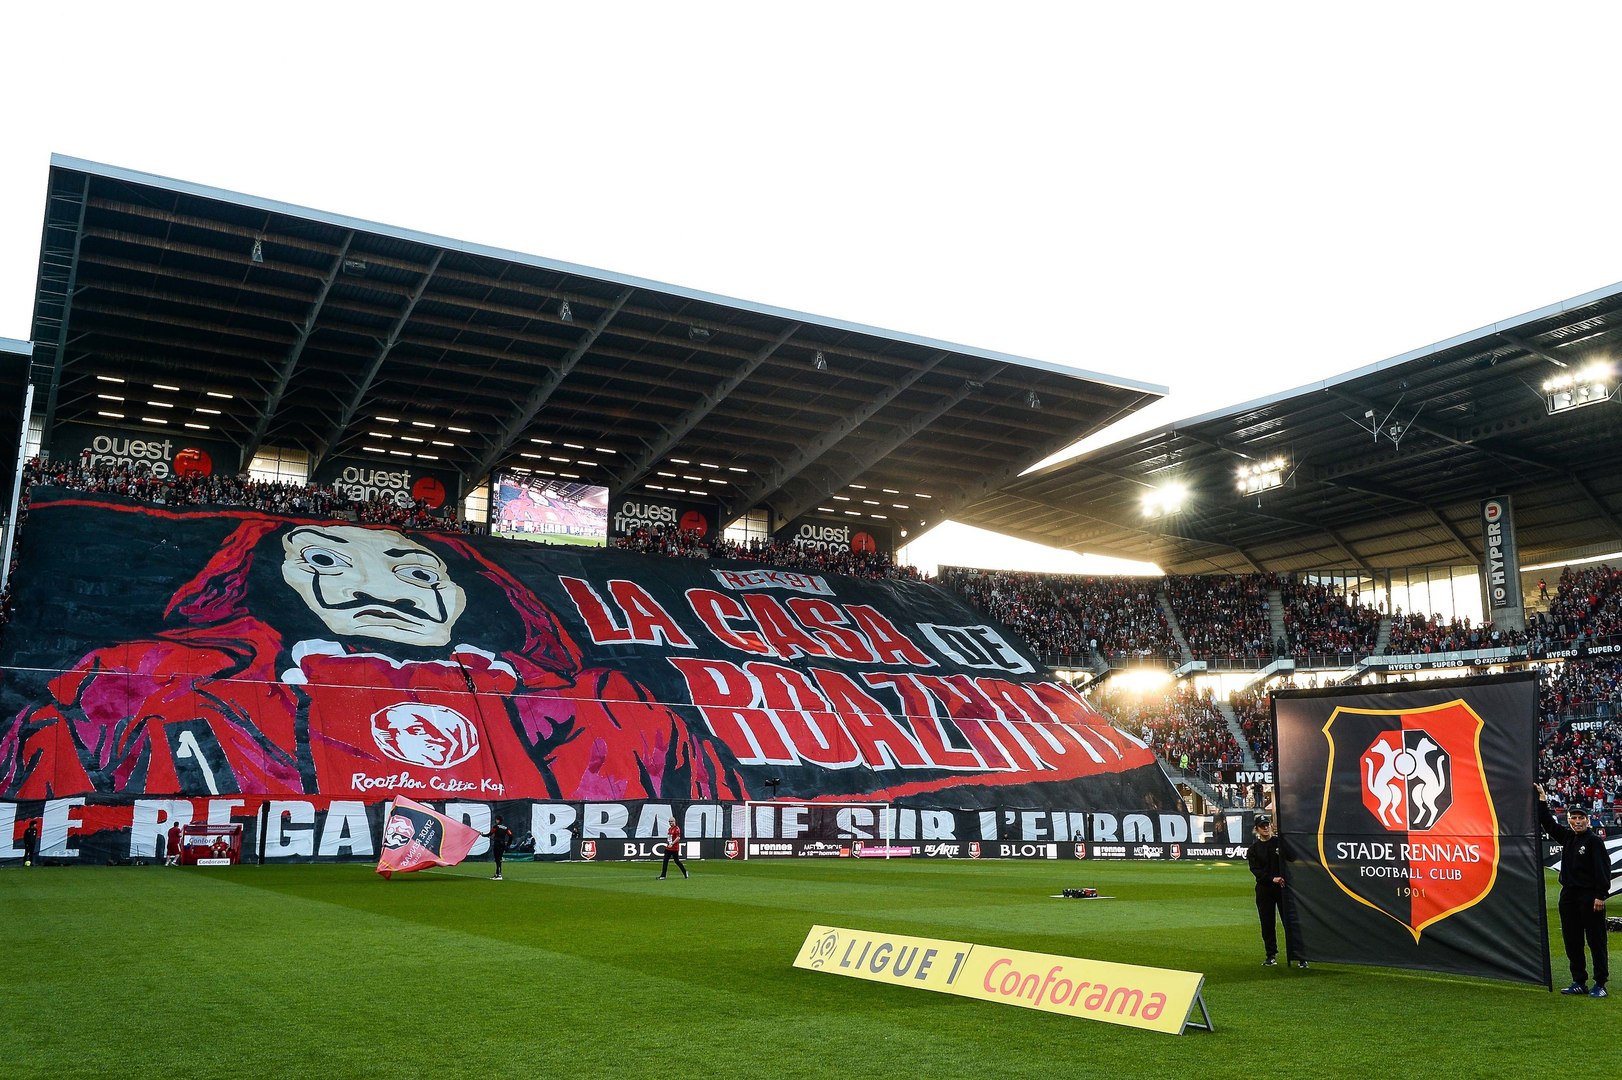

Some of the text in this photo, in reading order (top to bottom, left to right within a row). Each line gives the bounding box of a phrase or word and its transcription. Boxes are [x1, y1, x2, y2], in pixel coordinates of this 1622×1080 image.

[93, 435, 173, 461] ouest
[343, 466, 411, 490] ouest
[622, 501, 678, 523] ouest
[800, 523, 850, 544] ouest
[1487, 522, 1506, 585] HYPER
[721, 570, 821, 592] RCK91
[558, 575, 1034, 673] LA CASA DE
[1482, 656, 1509, 664] express
[1546, 650, 1571, 659] HYPER
[1588, 645, 1613, 654] SUPER
[1388, 663, 1414, 671] HYPER
[1432, 660, 1456, 668] SUPER
[667, 656, 1150, 772] ROAZHON
[351, 772, 426, 792] Roazhon
[429, 776, 477, 792] Celtic
[0, 797, 86, 857] LE
[760, 843, 793, 851] rennes
[1000, 844, 1047, 857] BLOT
[1336, 842, 1480, 863] STADE RENNAIS
[1360, 866, 1462, 880] FOOTBALL CLUB
[1396, 887, 1426, 898] 1901
[840, 939, 965, 985] LIGUE 1
[983, 958, 1167, 1021] Conforama
